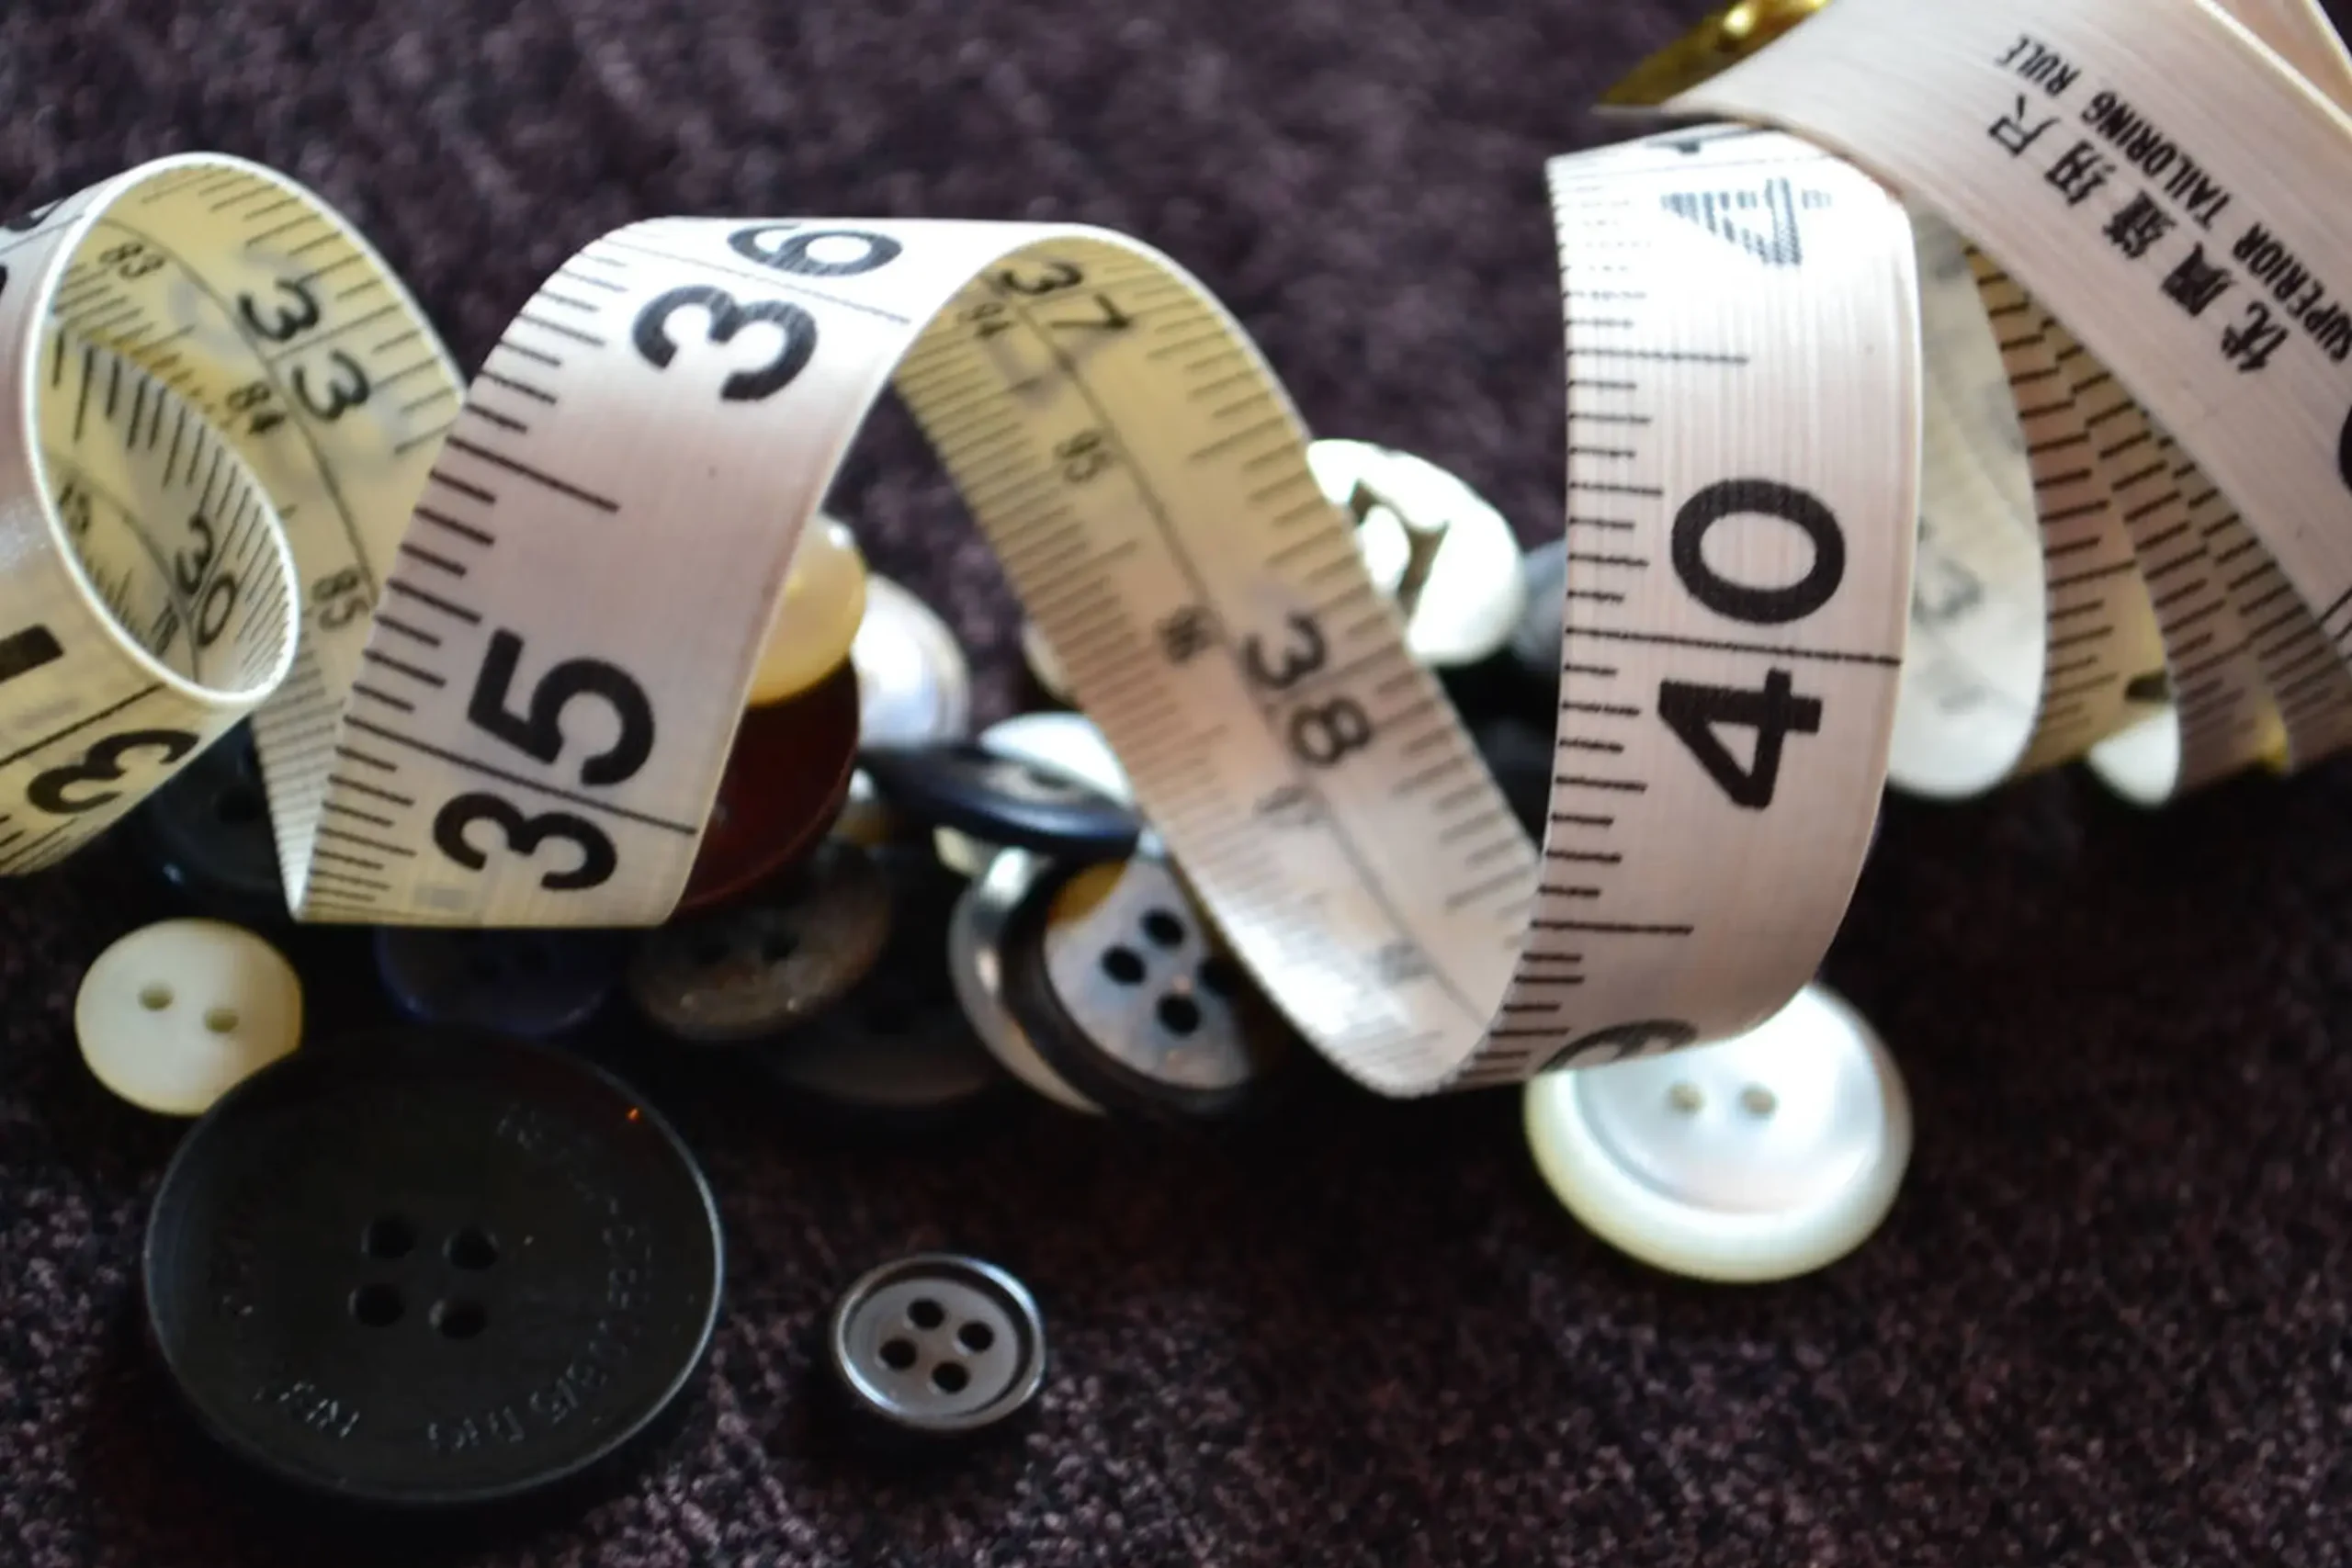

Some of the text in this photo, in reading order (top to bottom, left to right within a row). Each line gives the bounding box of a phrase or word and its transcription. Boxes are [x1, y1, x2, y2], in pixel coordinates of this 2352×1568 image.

[1996, 33, 2352, 363] SUPERIOR TAILORING RULE
[237, 277, 371, 423] 33
[631, 223, 904, 403] 36
[994, 261, 1136, 333] 37
[175, 513, 237, 648] 30
[1657, 477, 1847, 812] 40
[433, 626, 656, 891] 35
[1242, 612, 1373, 770] 38
